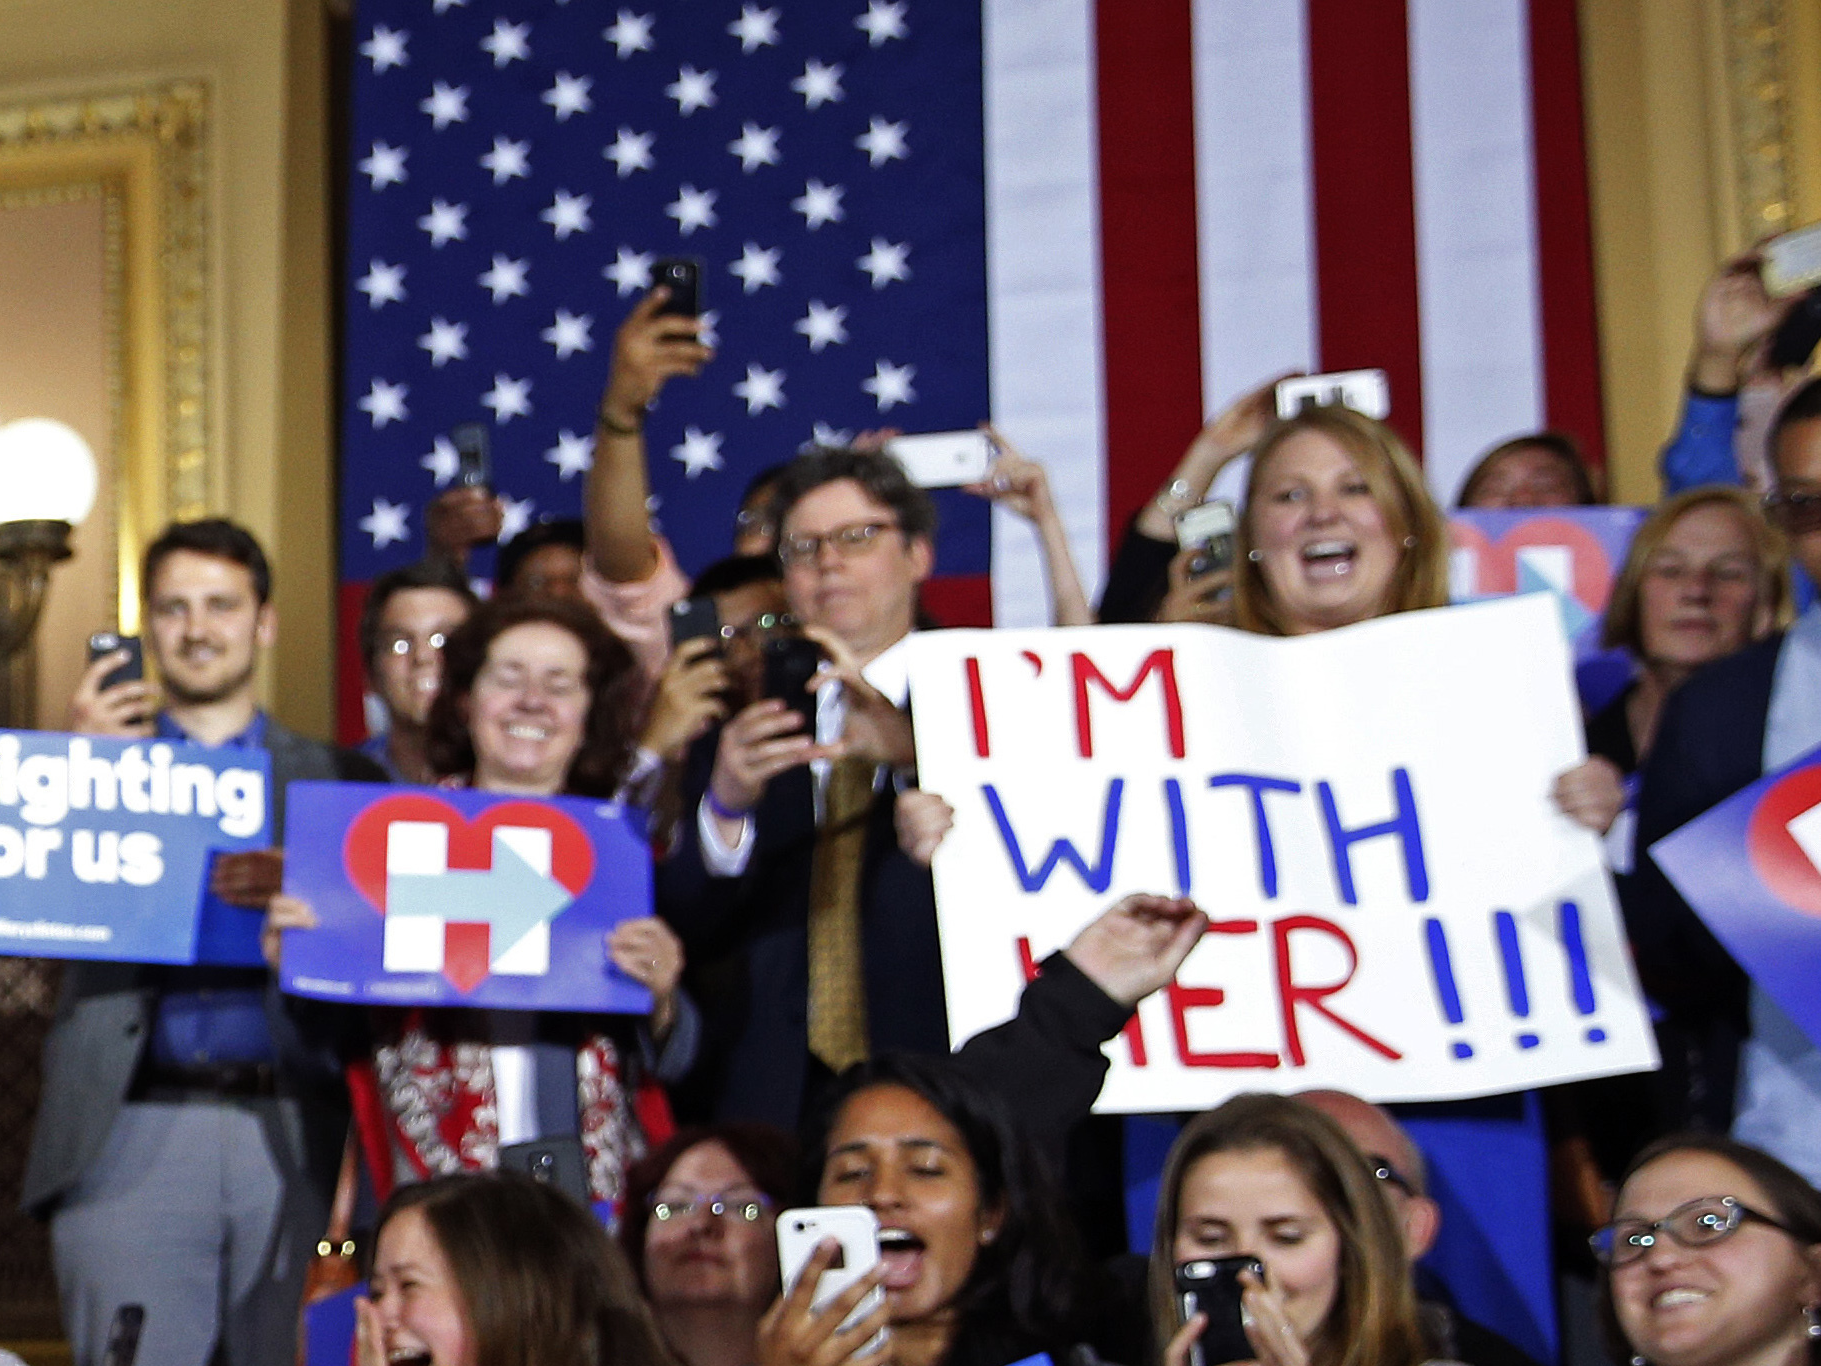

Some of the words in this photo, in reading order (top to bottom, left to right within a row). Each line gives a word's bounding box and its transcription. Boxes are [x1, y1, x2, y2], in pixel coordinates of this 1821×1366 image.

[965, 647, 1185, 758] I'M
[71, 828, 165, 887] us
[982, 767, 1429, 905] WITH
